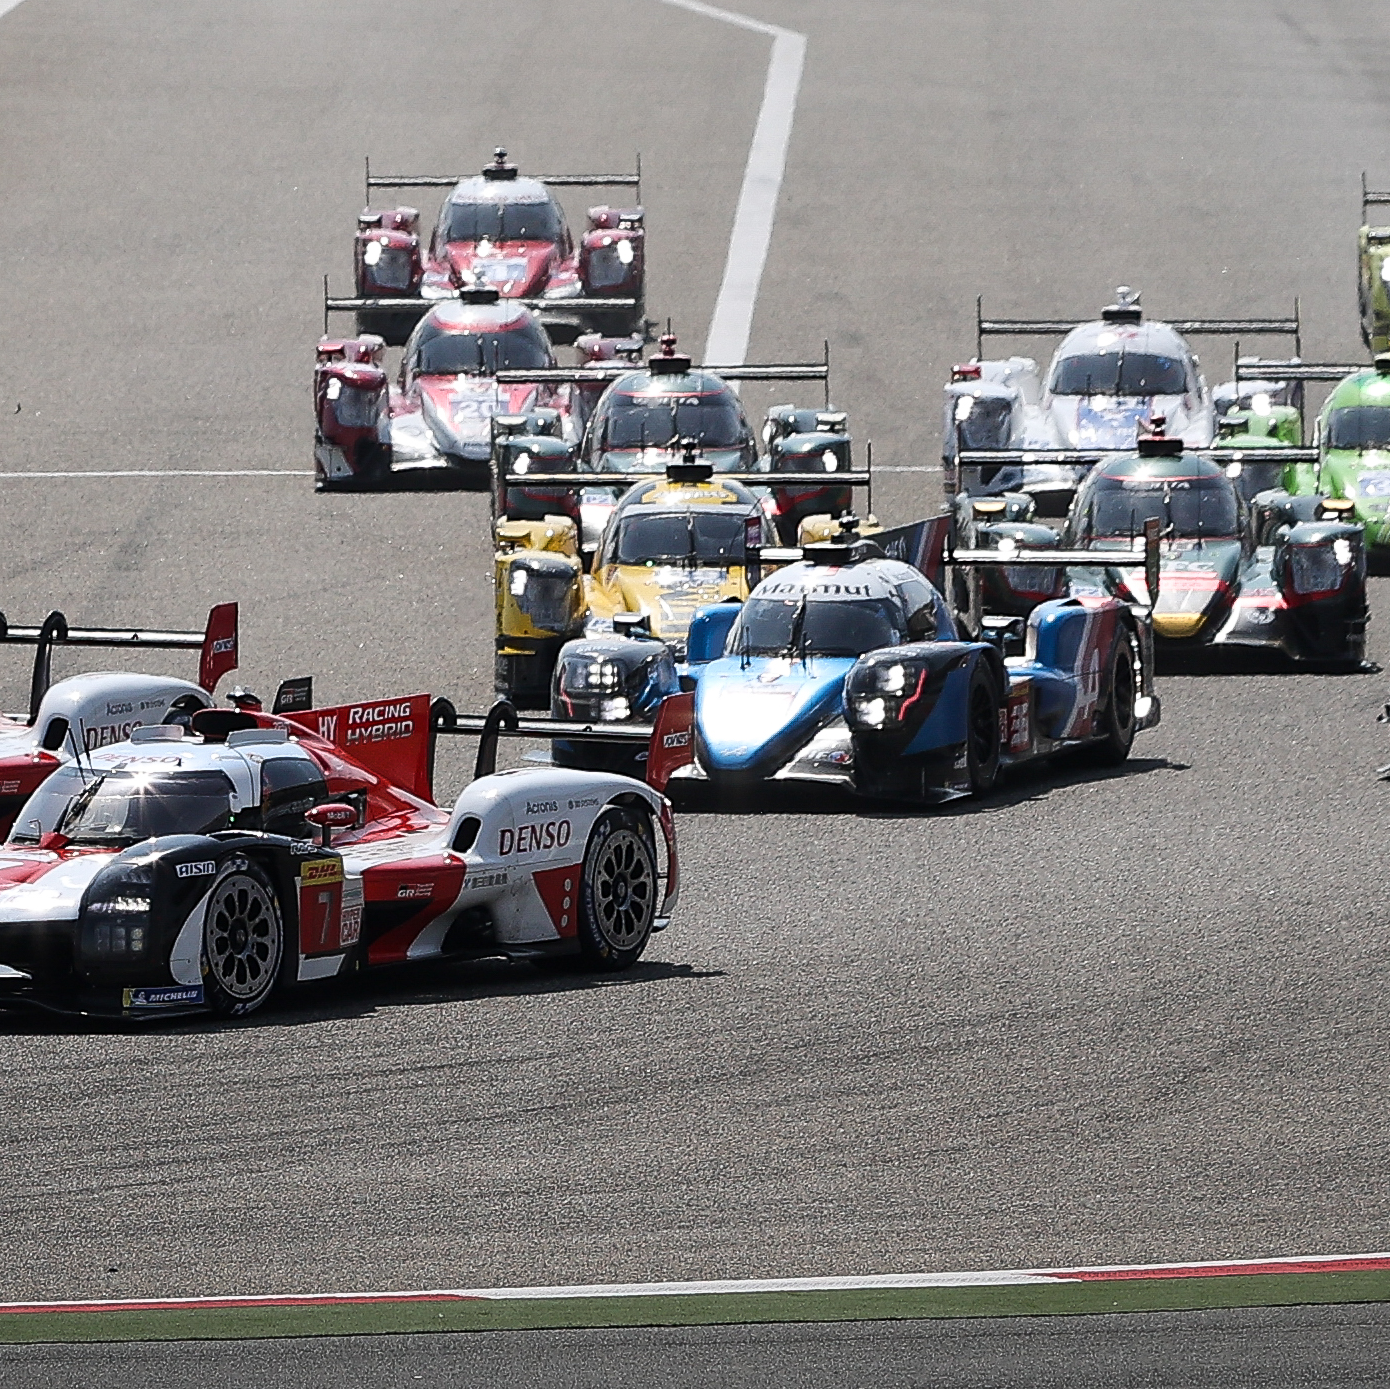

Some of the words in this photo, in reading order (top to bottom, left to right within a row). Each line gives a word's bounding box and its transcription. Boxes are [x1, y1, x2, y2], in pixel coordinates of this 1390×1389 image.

[318, 716, 338, 741] HY
[348, 702, 411, 725] RACING
[345, 721, 414, 746] HYBRID
[526, 800, 559, 815] Acronis
[499, 820, 571, 856] DENSO
[178, 861, 215, 876] AISIN
[307, 863, 338, 879] DHL
[397, 889, 415, 898] GR
[318, 891, 334, 944] 7
[149, 989, 198, 1002] MICHELIN
